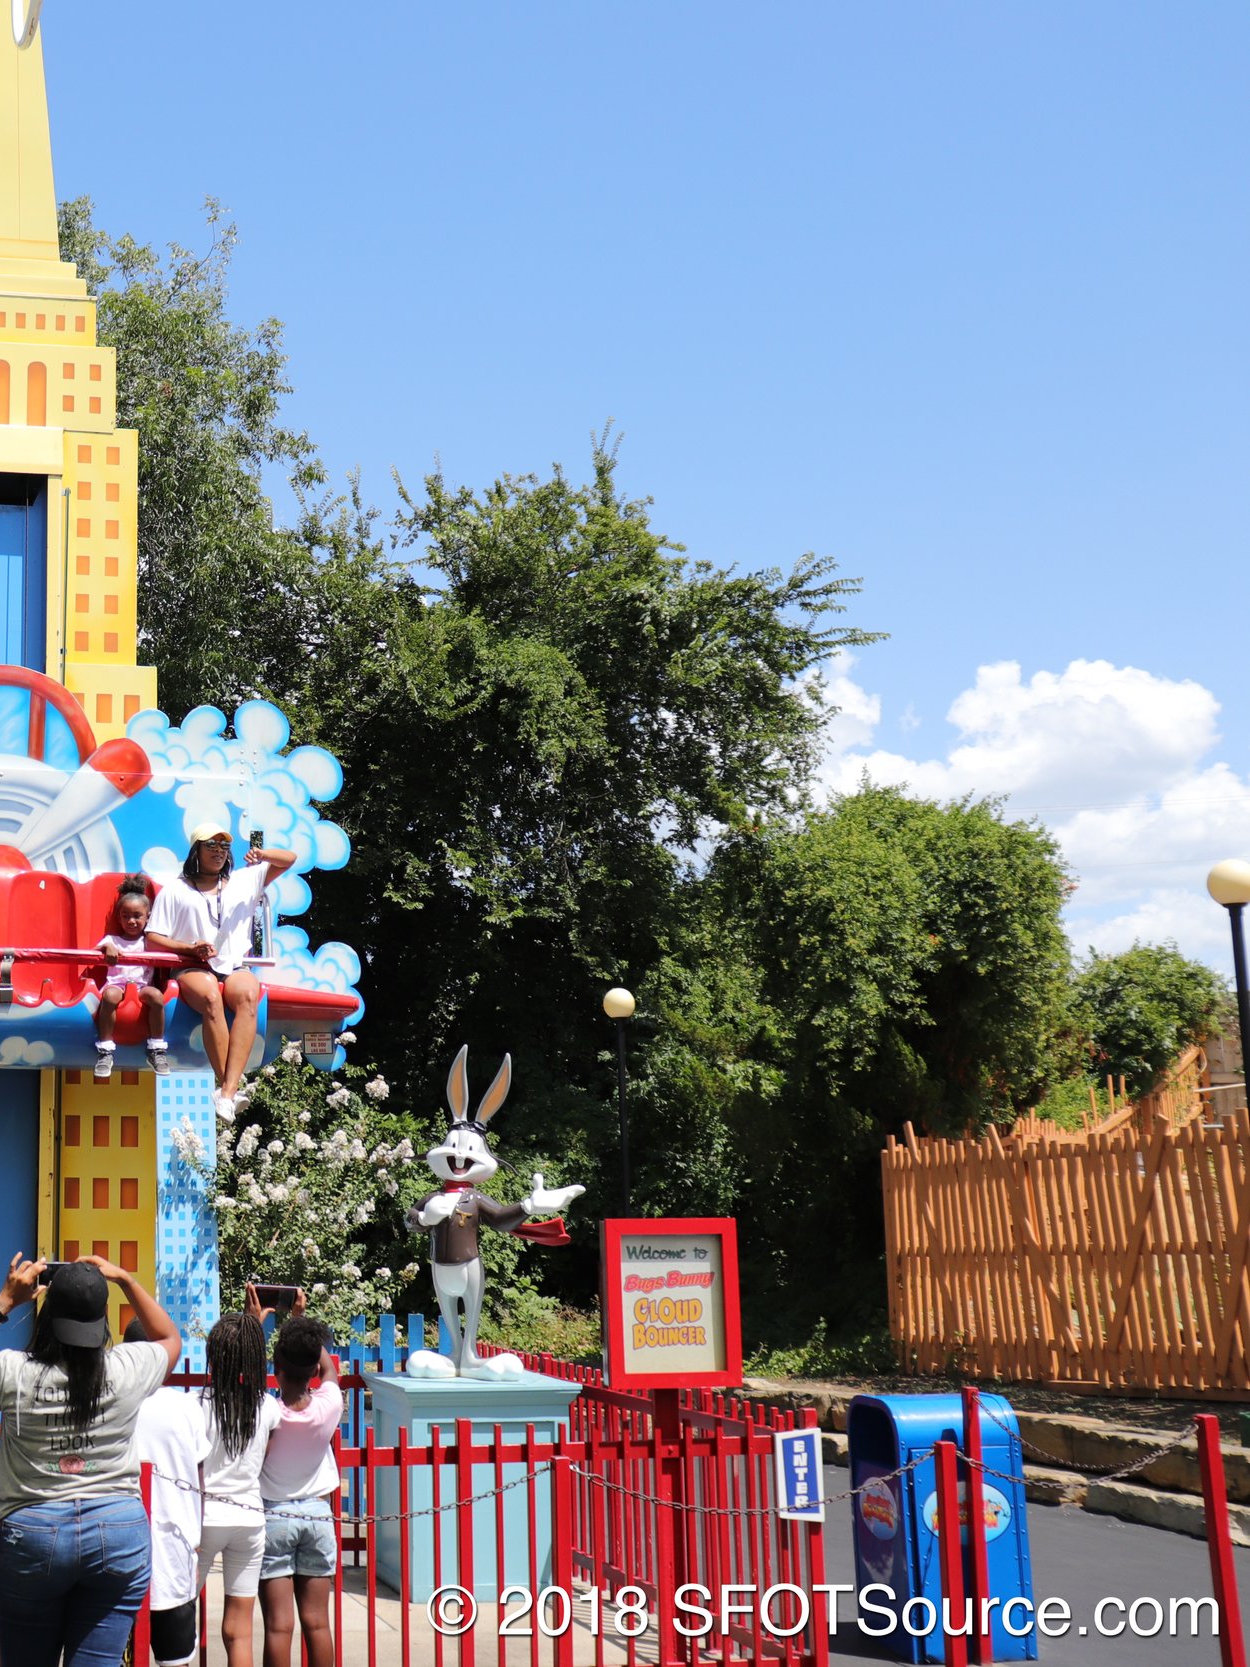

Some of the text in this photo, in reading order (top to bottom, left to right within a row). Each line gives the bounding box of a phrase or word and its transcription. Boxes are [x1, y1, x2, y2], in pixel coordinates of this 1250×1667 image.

[39, 880, 46, 890] 4
[626, 1244, 708, 1260] Welcome to
[623, 1270, 715, 1294] Bugs Bunny
[633, 1297, 703, 1325] CLOUD
[632, 1323, 707, 1350] BOUNCER
[50, 1435, 96, 1451] LOOK
[793, 1440, 809, 1509] ENTER
